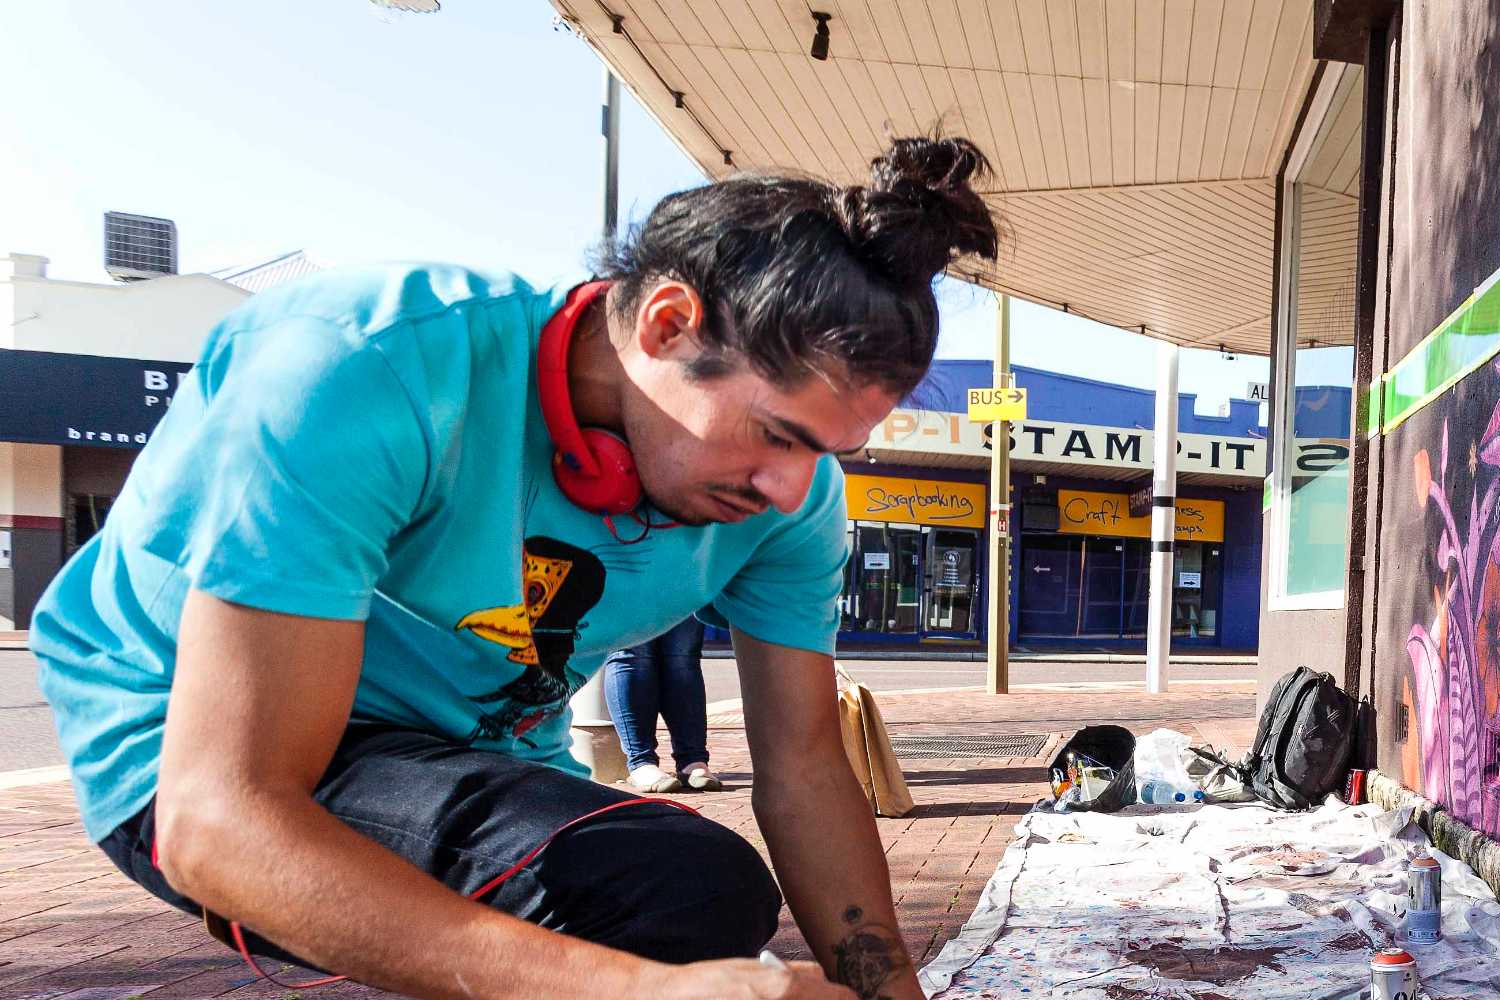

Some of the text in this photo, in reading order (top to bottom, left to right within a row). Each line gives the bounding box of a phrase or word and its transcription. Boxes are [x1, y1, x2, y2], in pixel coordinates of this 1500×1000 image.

[970, 391, 1002, 405] BUS
[67, 427, 148, 443] brand
[866, 484, 974, 519] Scrapbooking
[1064, 497, 1122, 525] Craft
